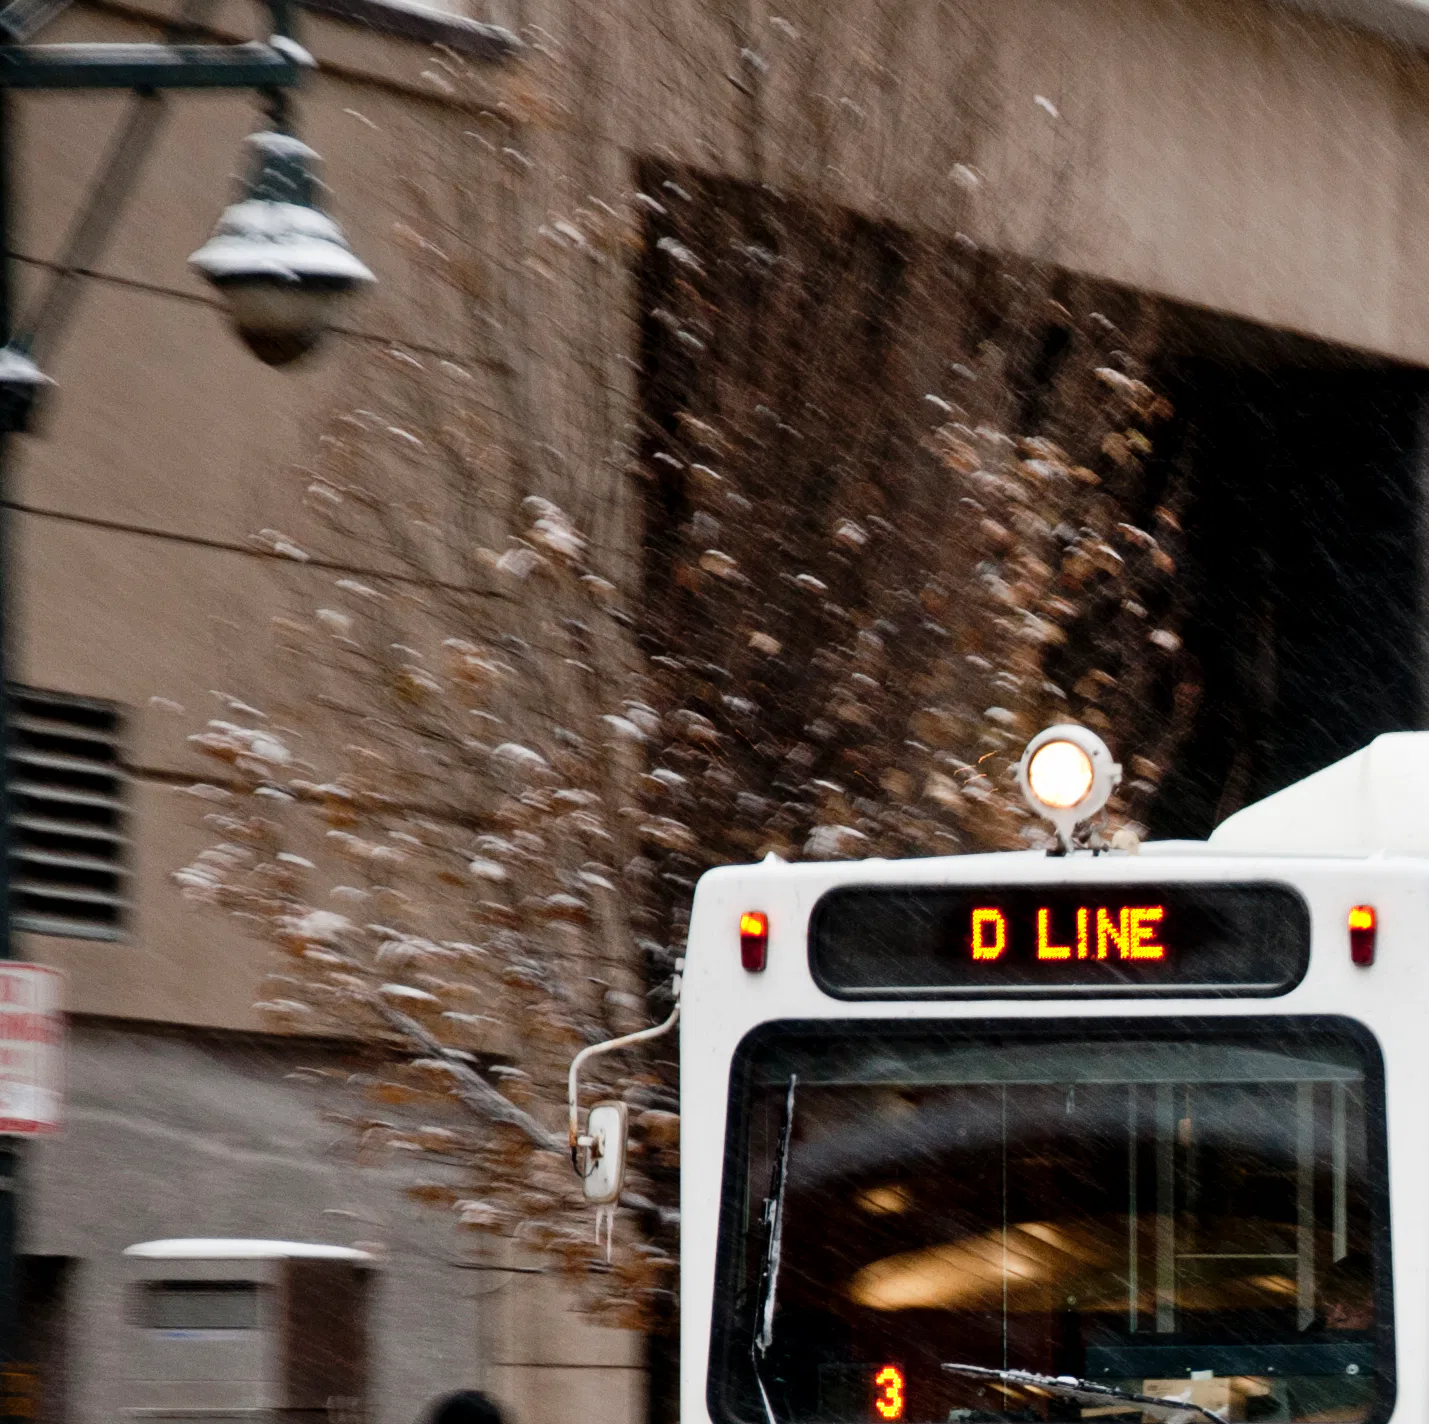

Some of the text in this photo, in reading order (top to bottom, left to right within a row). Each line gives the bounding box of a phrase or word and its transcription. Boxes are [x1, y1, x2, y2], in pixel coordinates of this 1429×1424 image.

[971, 906, 1164, 961] D LINE
[875, 1366, 903, 1419] 3
